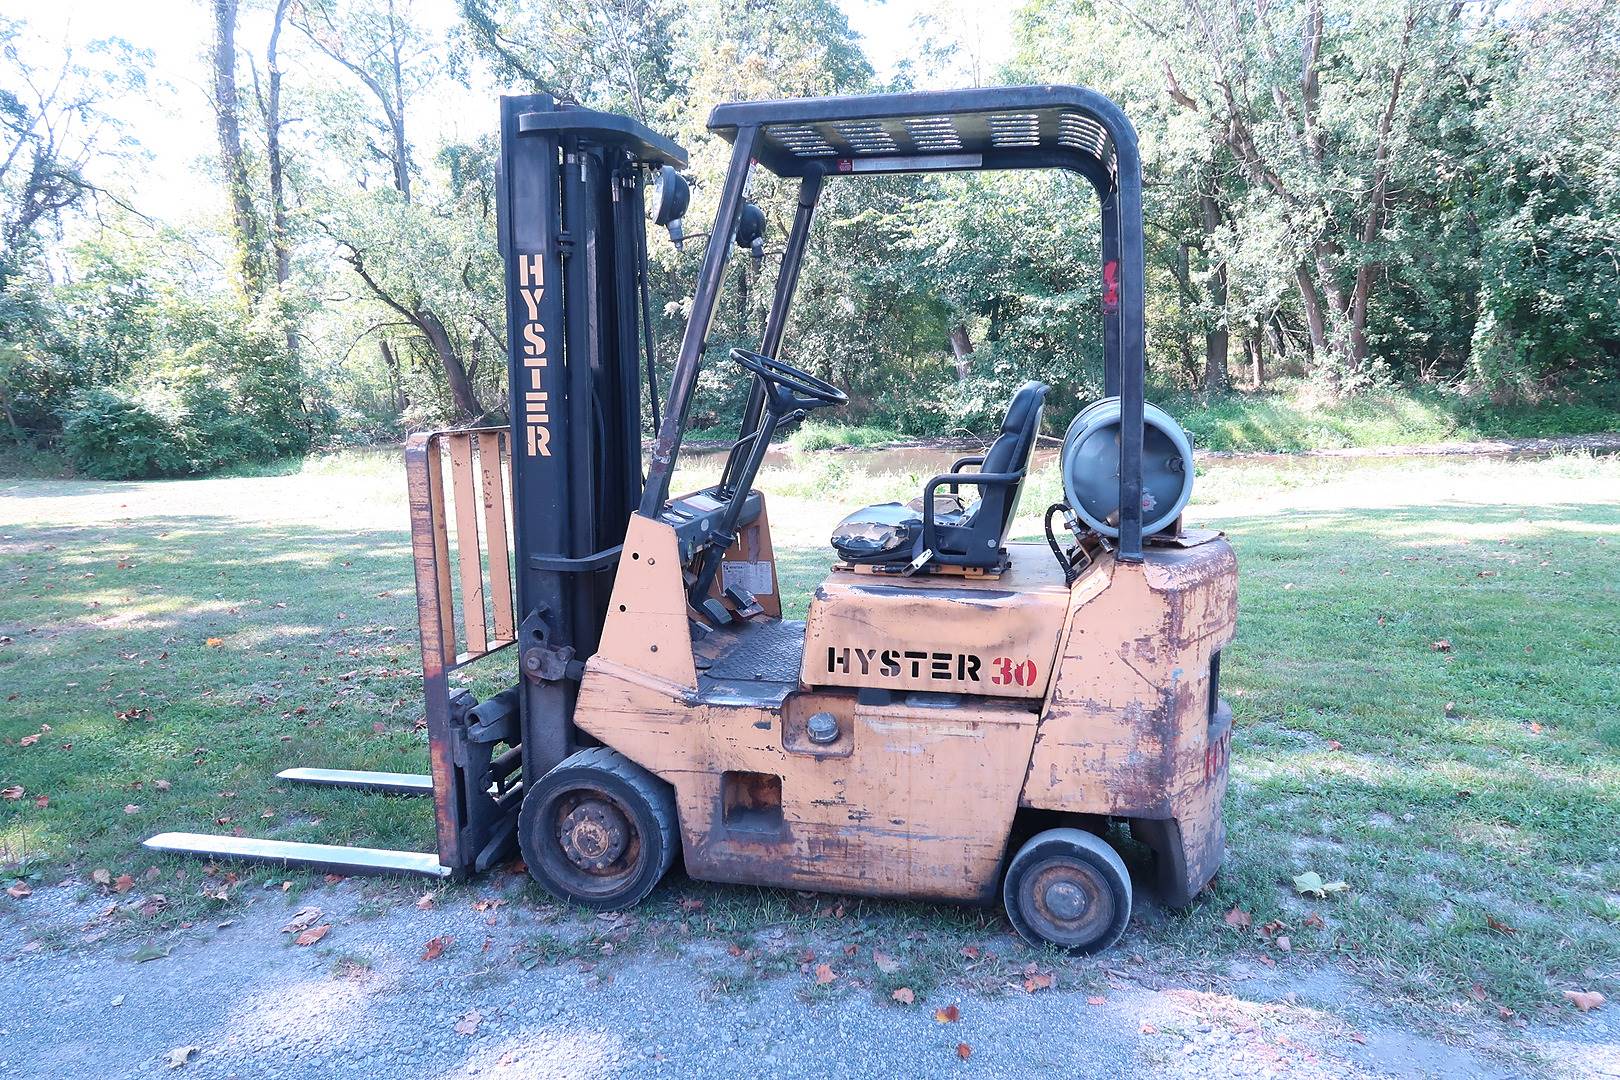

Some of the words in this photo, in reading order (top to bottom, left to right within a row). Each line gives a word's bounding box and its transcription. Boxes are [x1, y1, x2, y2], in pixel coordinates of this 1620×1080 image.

[518, 253, 552, 457] HYSTER
[827, 646, 982, 682] HYSTER
[991, 656, 1038, 687] 30
